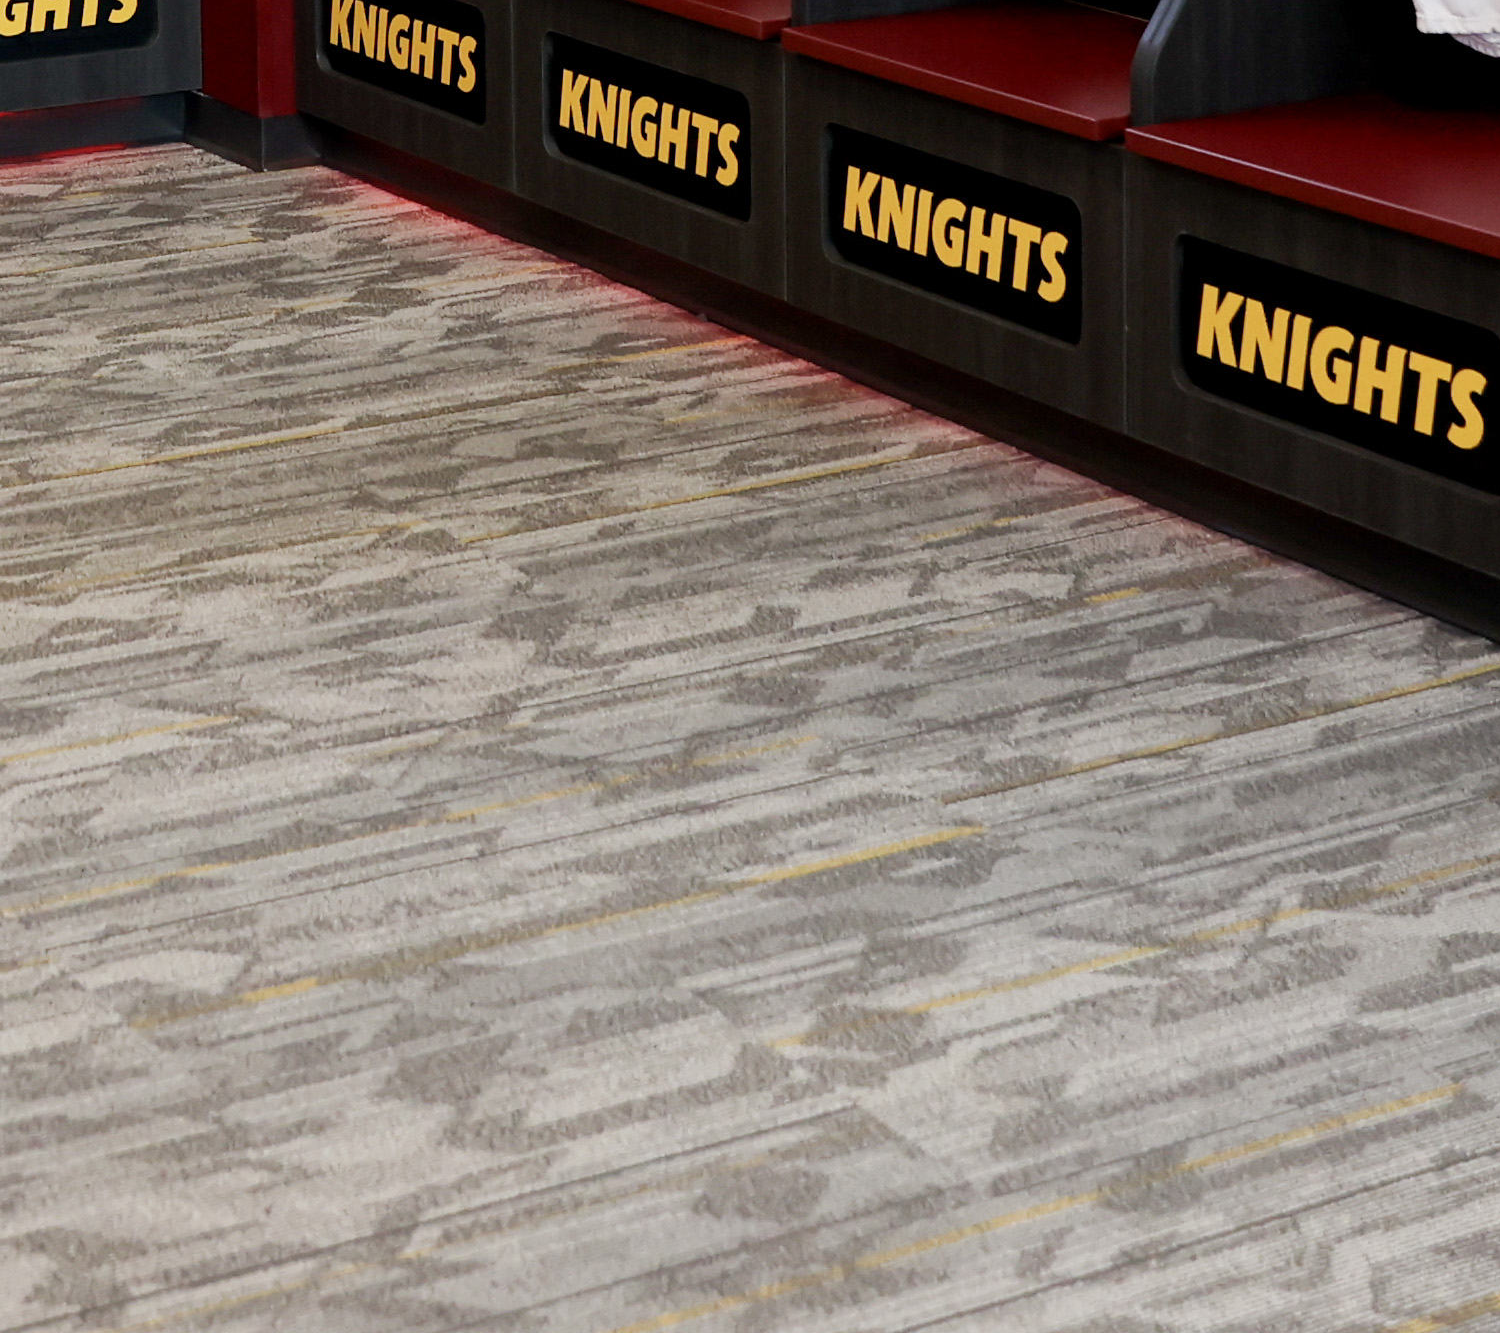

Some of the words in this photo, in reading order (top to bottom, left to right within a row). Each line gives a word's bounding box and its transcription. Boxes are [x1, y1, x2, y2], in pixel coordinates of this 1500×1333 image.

[559, 68, 740, 187] KNIGHTS
[843, 165, 1068, 303] KNIGHTS
[1196, 284, 1488, 450] KNIGHTS
